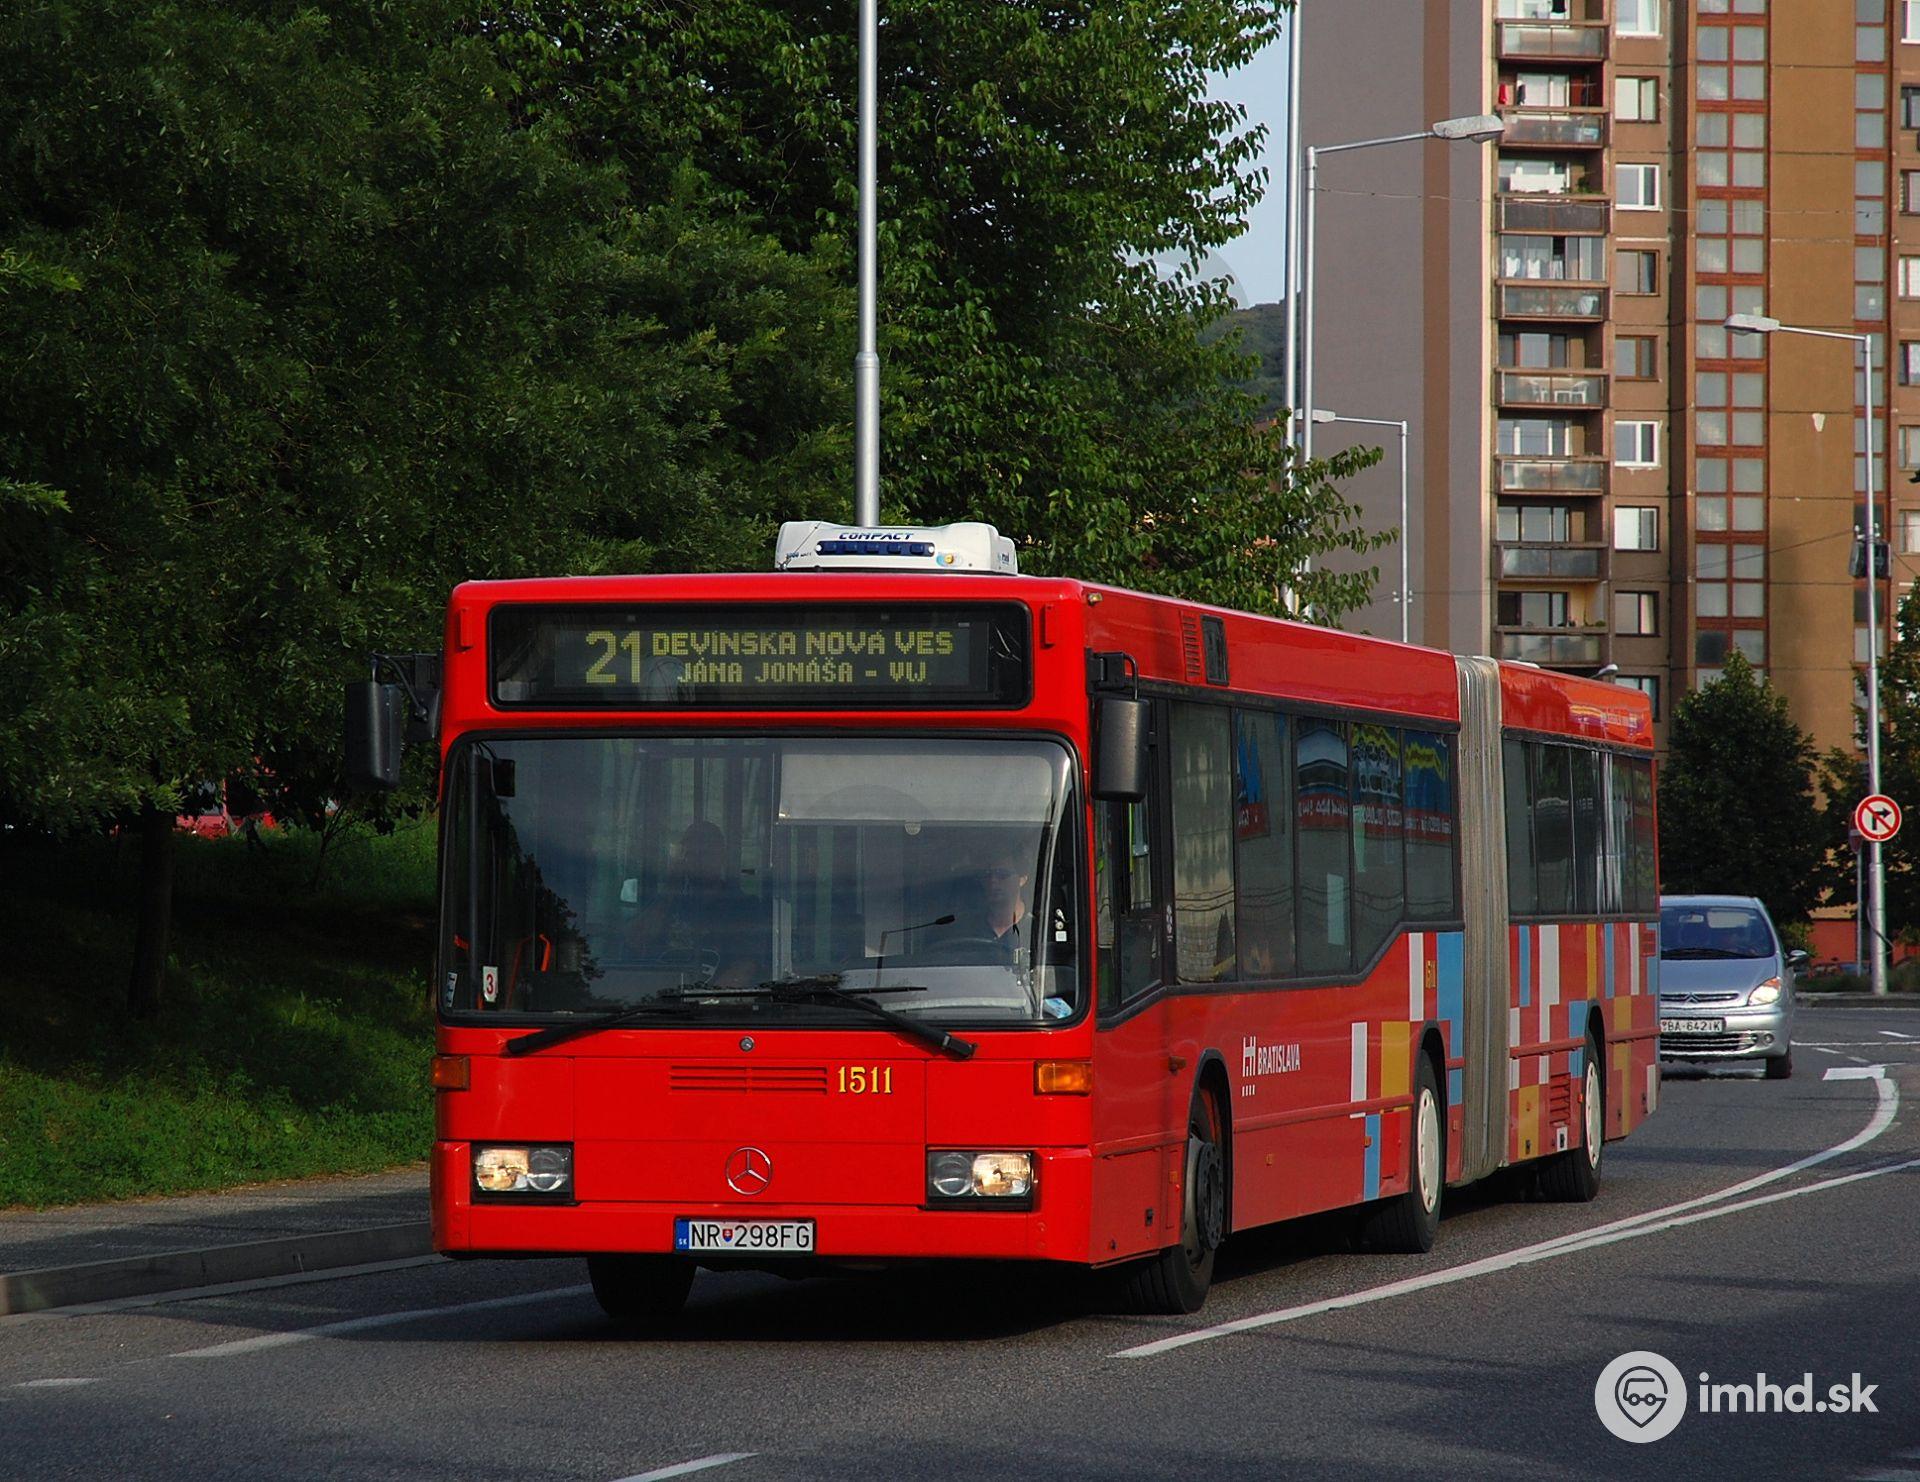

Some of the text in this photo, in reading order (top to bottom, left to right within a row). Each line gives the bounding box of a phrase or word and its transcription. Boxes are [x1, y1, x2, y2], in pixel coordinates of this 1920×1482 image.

[839, 532, 914, 540] COMPACT
[652, 629, 953, 655] DEVÍNSKA NOVÁ VES
[586, 630, 640, 683] 21
[677, 657, 743, 683] JÁNA
[755, 657, 853, 683] JONÁŠA
[486, 973, 494, 995] 3
[1258, 1044, 1300, 1075] BRATISLAVA
[838, 1066, 891, 1093] 1511
